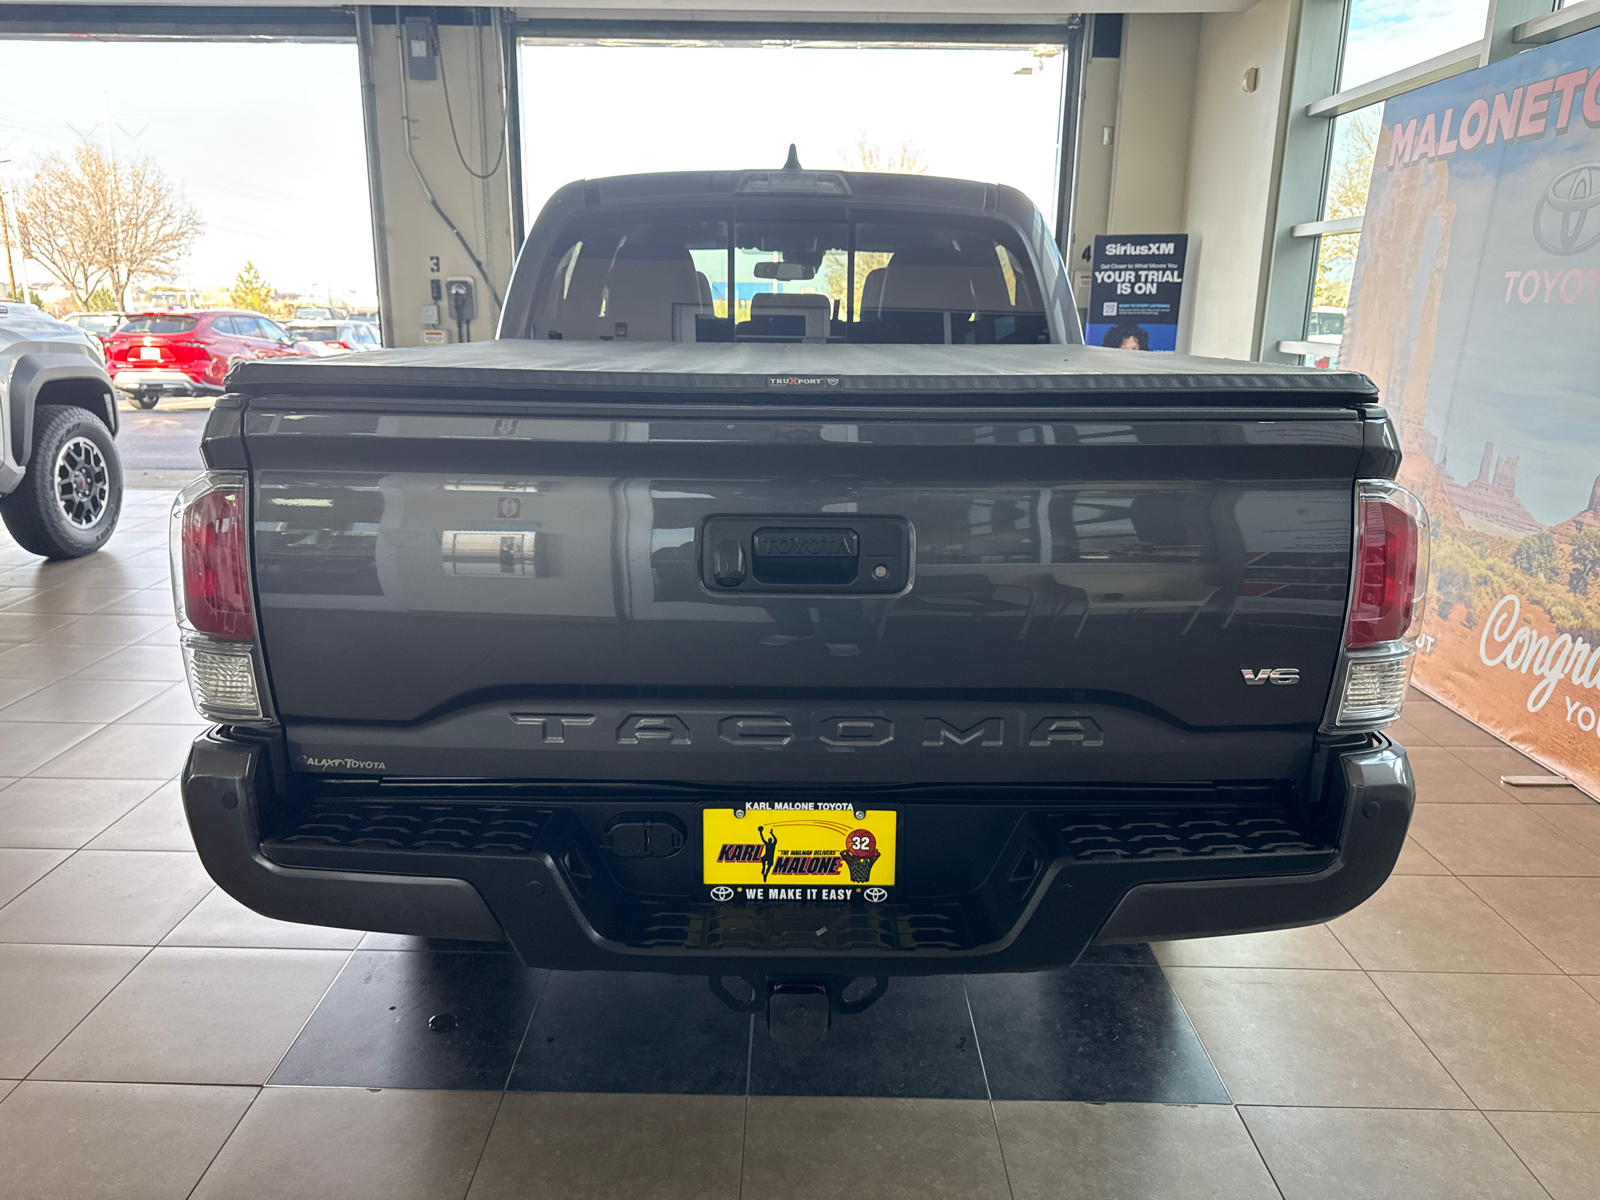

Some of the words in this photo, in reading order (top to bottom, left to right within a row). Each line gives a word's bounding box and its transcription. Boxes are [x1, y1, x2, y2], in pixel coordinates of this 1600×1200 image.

[1081, 245, 1091, 262] 4
[1105, 243, 1175, 256] SiriusXM
[429, 256, 440, 273] 3
[1111, 262, 1127, 270] Closer
[1094, 270, 1136, 283] YOUR
[1138, 270, 1182, 283] TRIAL
[1116, 282, 1132, 295] IS
[1134, 282, 1158, 295] ON
[770, 377, 822, 385] TRUXPORT
[762, 537, 852, 555] TOYOTA
[1240, 668, 1300, 686] V6
[1565, 695, 1600, 739] YO
[509, 712, 1104, 747] TACOMA
[344, 758, 387, 770] TOYOTA
[745, 802, 772, 811] KARL
[774, 802, 814, 811] MALONE
[816, 802, 854, 812] TOYOTA
[852, 836, 870, 851] 32
[717, 844, 766, 863] KARL
[771, 856, 843, 876] MALONE
[745, 888, 764, 900] WE
[768, 888, 802, 900] MAKE
[806, 888, 818, 900] IT
[822, 888, 853, 900] EASY
